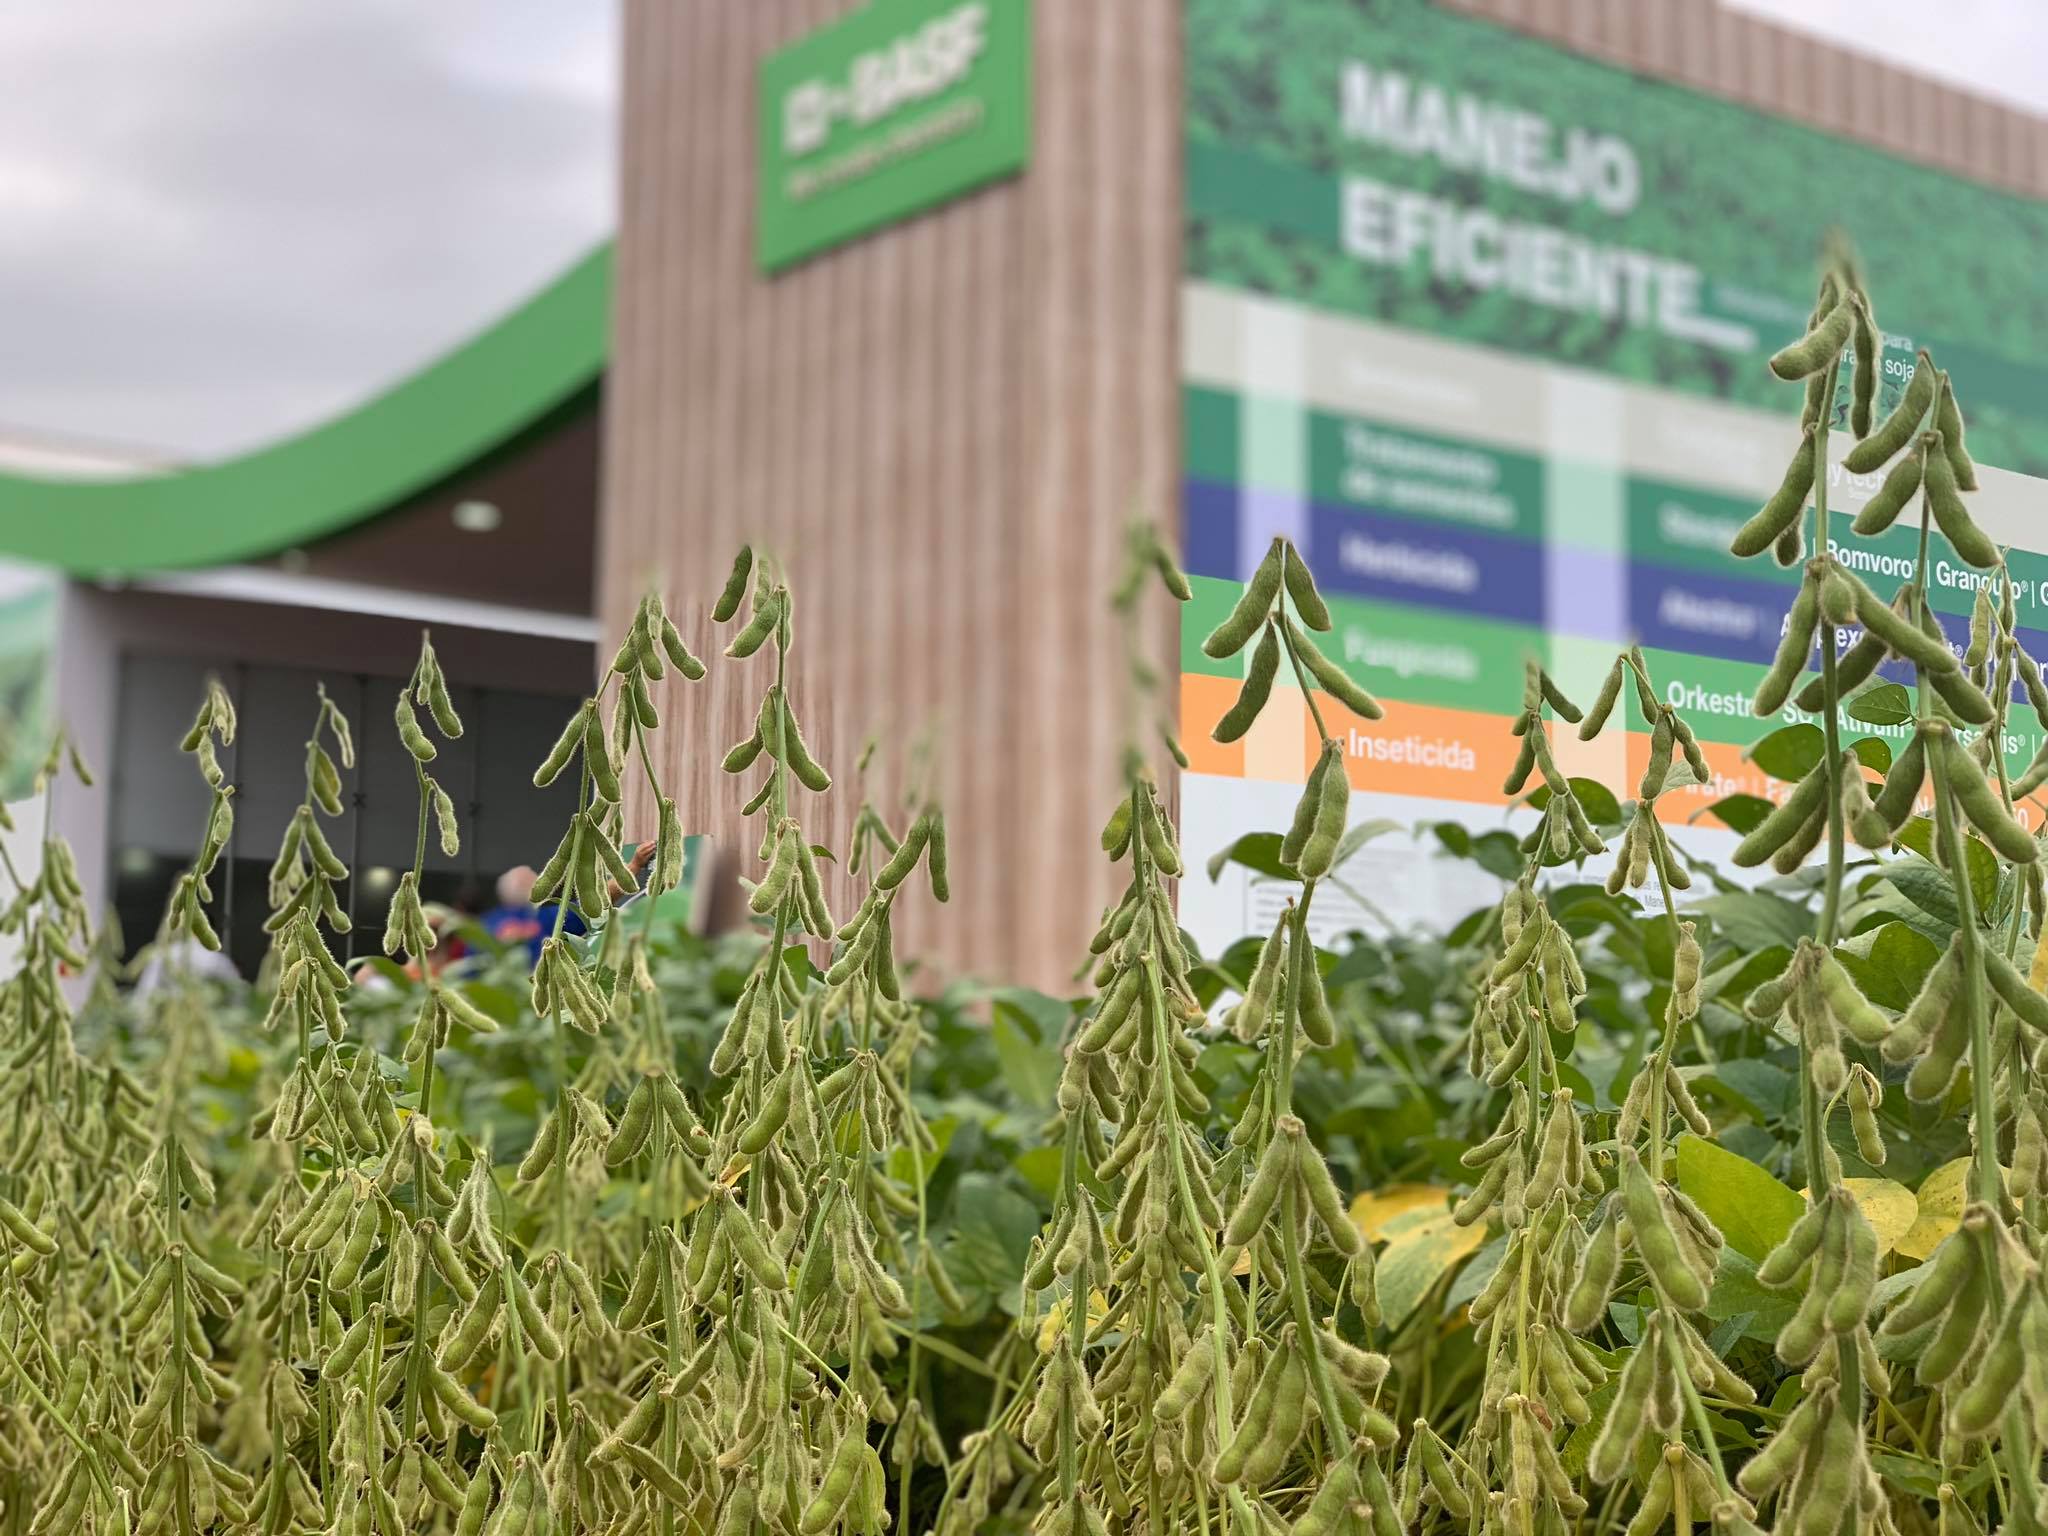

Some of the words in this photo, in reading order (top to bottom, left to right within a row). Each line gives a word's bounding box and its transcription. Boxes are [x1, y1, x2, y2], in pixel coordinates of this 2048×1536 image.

[1341, 62, 1641, 215] MANEJO
[1885, 358, 1915, 382] soja
[1667, 681, 1753, 717] Orkestr
[1349, 728, 1476, 771] Inseticida
